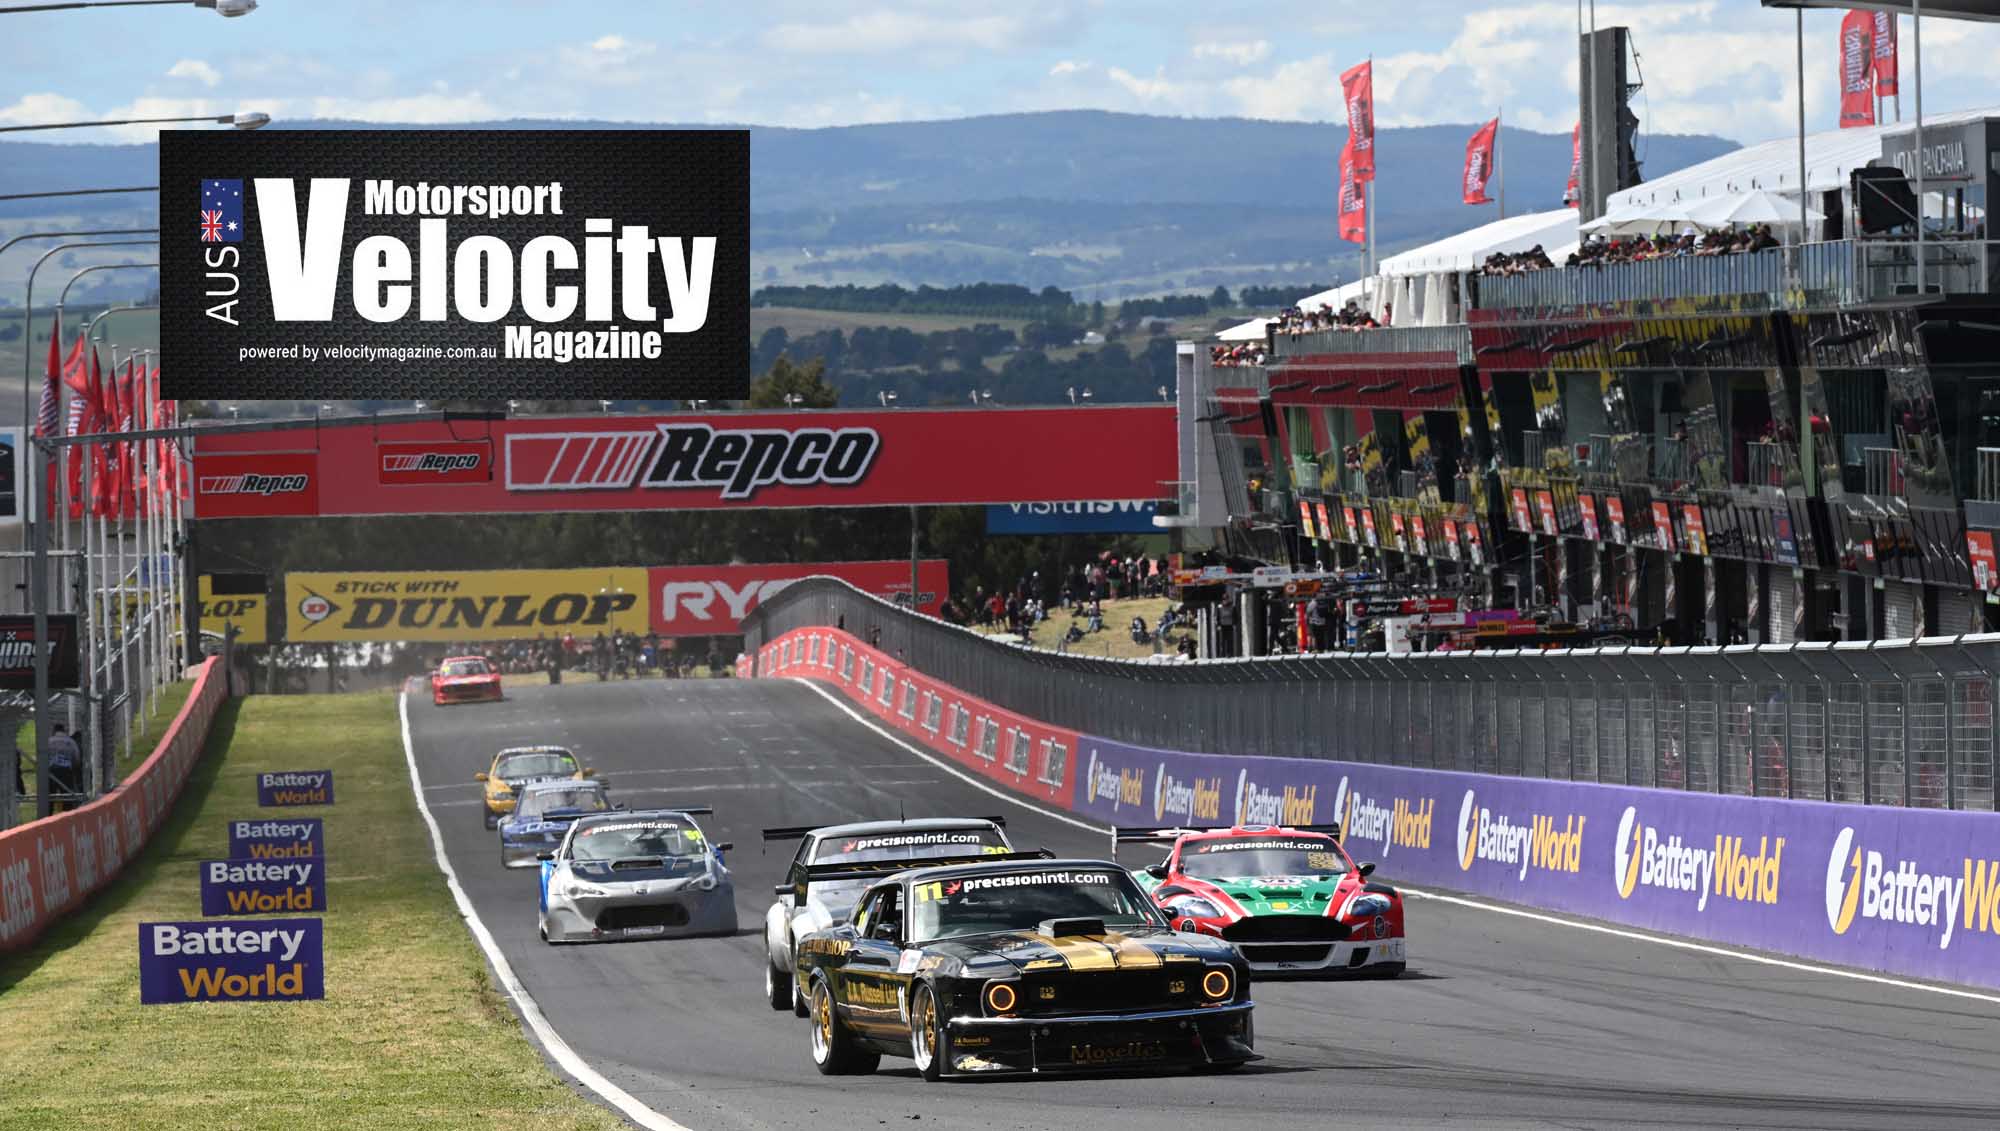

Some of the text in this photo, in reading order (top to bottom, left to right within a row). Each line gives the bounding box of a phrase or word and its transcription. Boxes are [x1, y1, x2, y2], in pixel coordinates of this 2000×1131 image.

[420, 453, 481, 471] Repco
[645, 425, 878, 495] Repco
[242, 474, 308, 496] Repco
[335, 580, 459, 593] STICK WITH
[342, 593, 637, 629] DUNLOP
[263, 774, 325, 789] Battery
[273, 789, 326, 804] World
[235, 822, 314, 841] Battery
[592, 821, 678, 835] precisionintl.com
[250, 842, 313, 859] World
[857, 833, 980, 850] precisionintl.com
[1211, 841, 1324, 853] precisionintl.com
[209, 863, 312, 885] Battery
[914, 872, 1109, 902] 11 precisionintl.com
[227, 887, 312, 912] World
[153, 926, 305, 961] Battery
[178, 963, 304, 998] World
